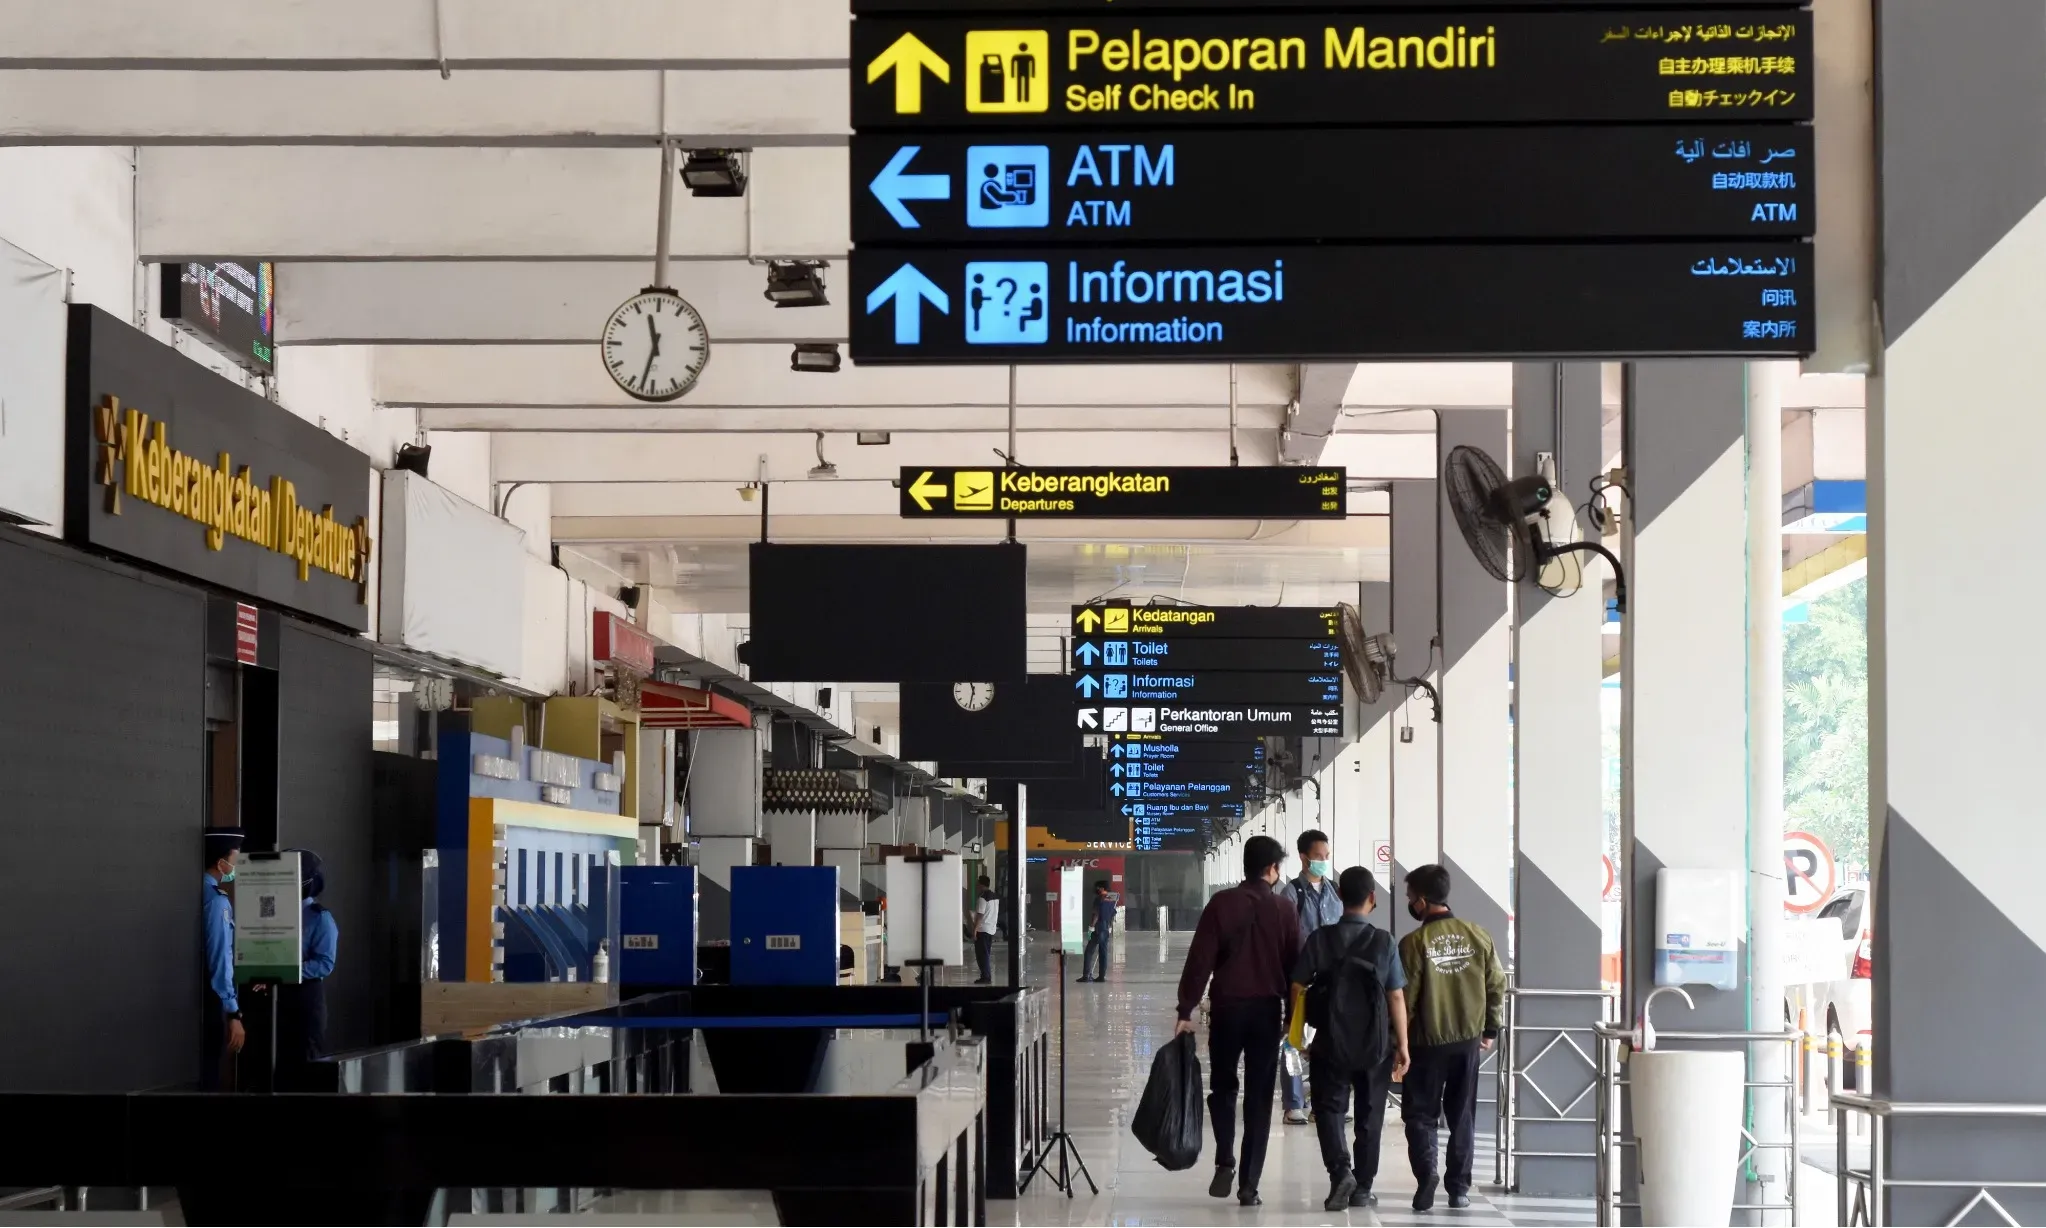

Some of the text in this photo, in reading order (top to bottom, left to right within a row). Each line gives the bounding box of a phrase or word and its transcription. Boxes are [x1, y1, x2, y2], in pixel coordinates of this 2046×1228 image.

[1067, 26, 1496, 81] Pelaporan Mandiri
[1658, 56, 1796, 76] 自主办理乘机手续
[1066, 84, 1254, 111] Self Check In
[1066, 144, 1175, 186] ATM
[1712, 172, 1796, 190] 自动取款机
[1066, 201, 1131, 226] ATM
[1751, 203, 1797, 222] ATM
[1067, 259, 1284, 304] Informasi
[1762, 288, 1797, 307] 问讯
[1066, 316, 1222, 343] Information
[1742, 320, 1797, 339] 案内所
[1001, 472, 1170, 496] Keberangkatan
[126, 407, 272, 552] Keberangkatan
[280, 479, 356, 582] Departure
[1001, 498, 1074, 513] Departures
[1132, 609, 1215, 625] Kedatangan
[1132, 624, 1164, 634] Arrivals
[1132, 642, 1168, 655] Toilet
[1132, 658, 1158, 666] Toilets
[1132, 674, 1194, 688] Informasi
[1132, 690, 1178, 699] Information
[1160, 708, 1292, 722] Perkantoran Umum
[1160, 724, 1218, 733] General Office
[1144, 744, 1179, 753] Musholla
[1144, 763, 1164, 772] Toilet
[1144, 782, 1230, 792] Pelayanan Pelanggan
[1146, 804, 1168, 813] Ruang
[1195, 804, 1208, 812] Bayi
[1070, 858, 1099, 868] KFC
[1784, 848, 1818, 896] P
